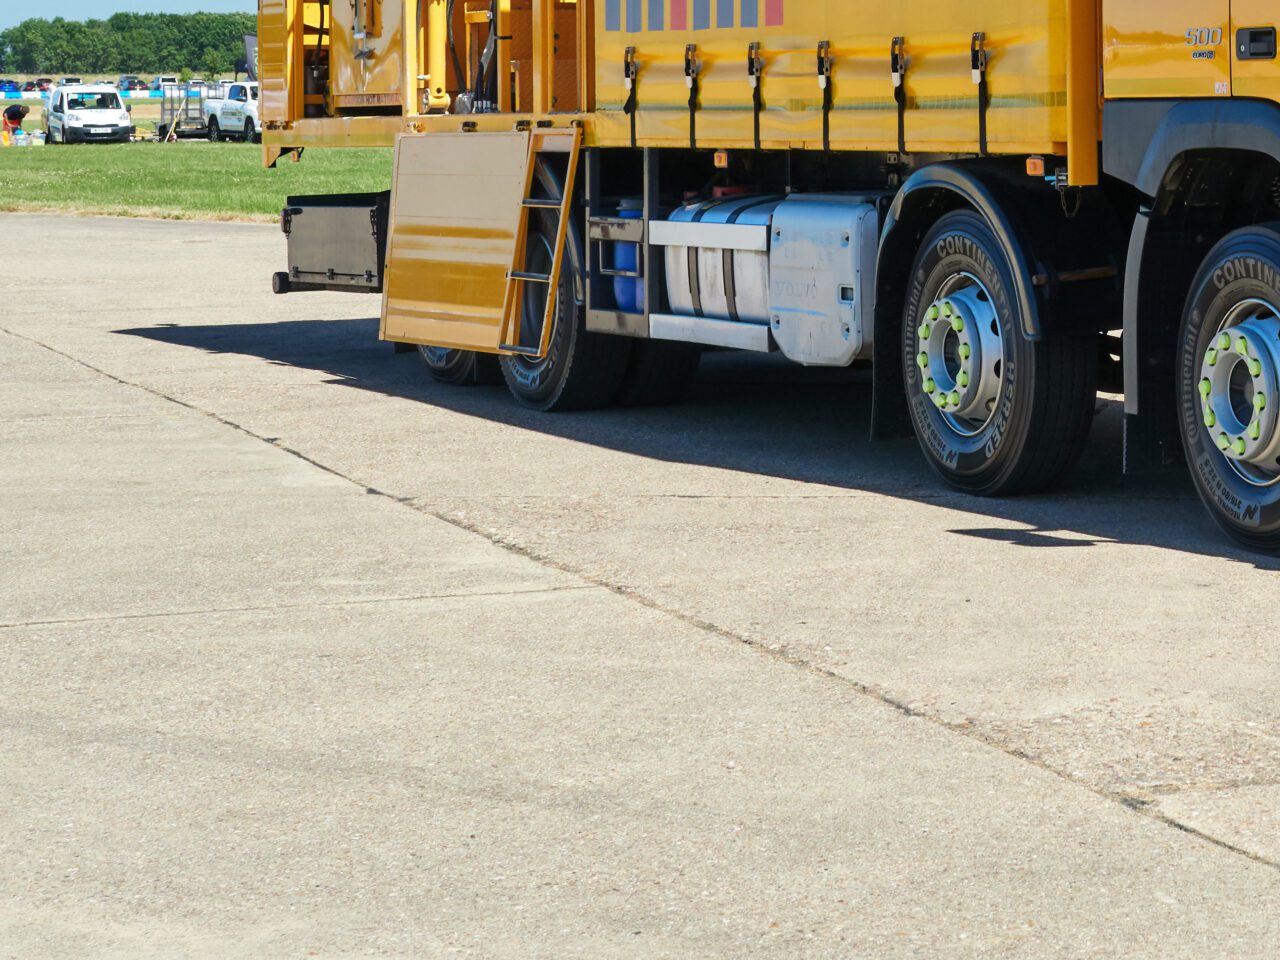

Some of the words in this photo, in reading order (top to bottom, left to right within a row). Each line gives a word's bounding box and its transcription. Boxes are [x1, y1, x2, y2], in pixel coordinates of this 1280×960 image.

[1185, 27, 1222, 46] 500
[937, 235, 1012, 330] CONTINENTAL
[1183, 324, 1200, 444] Continental
